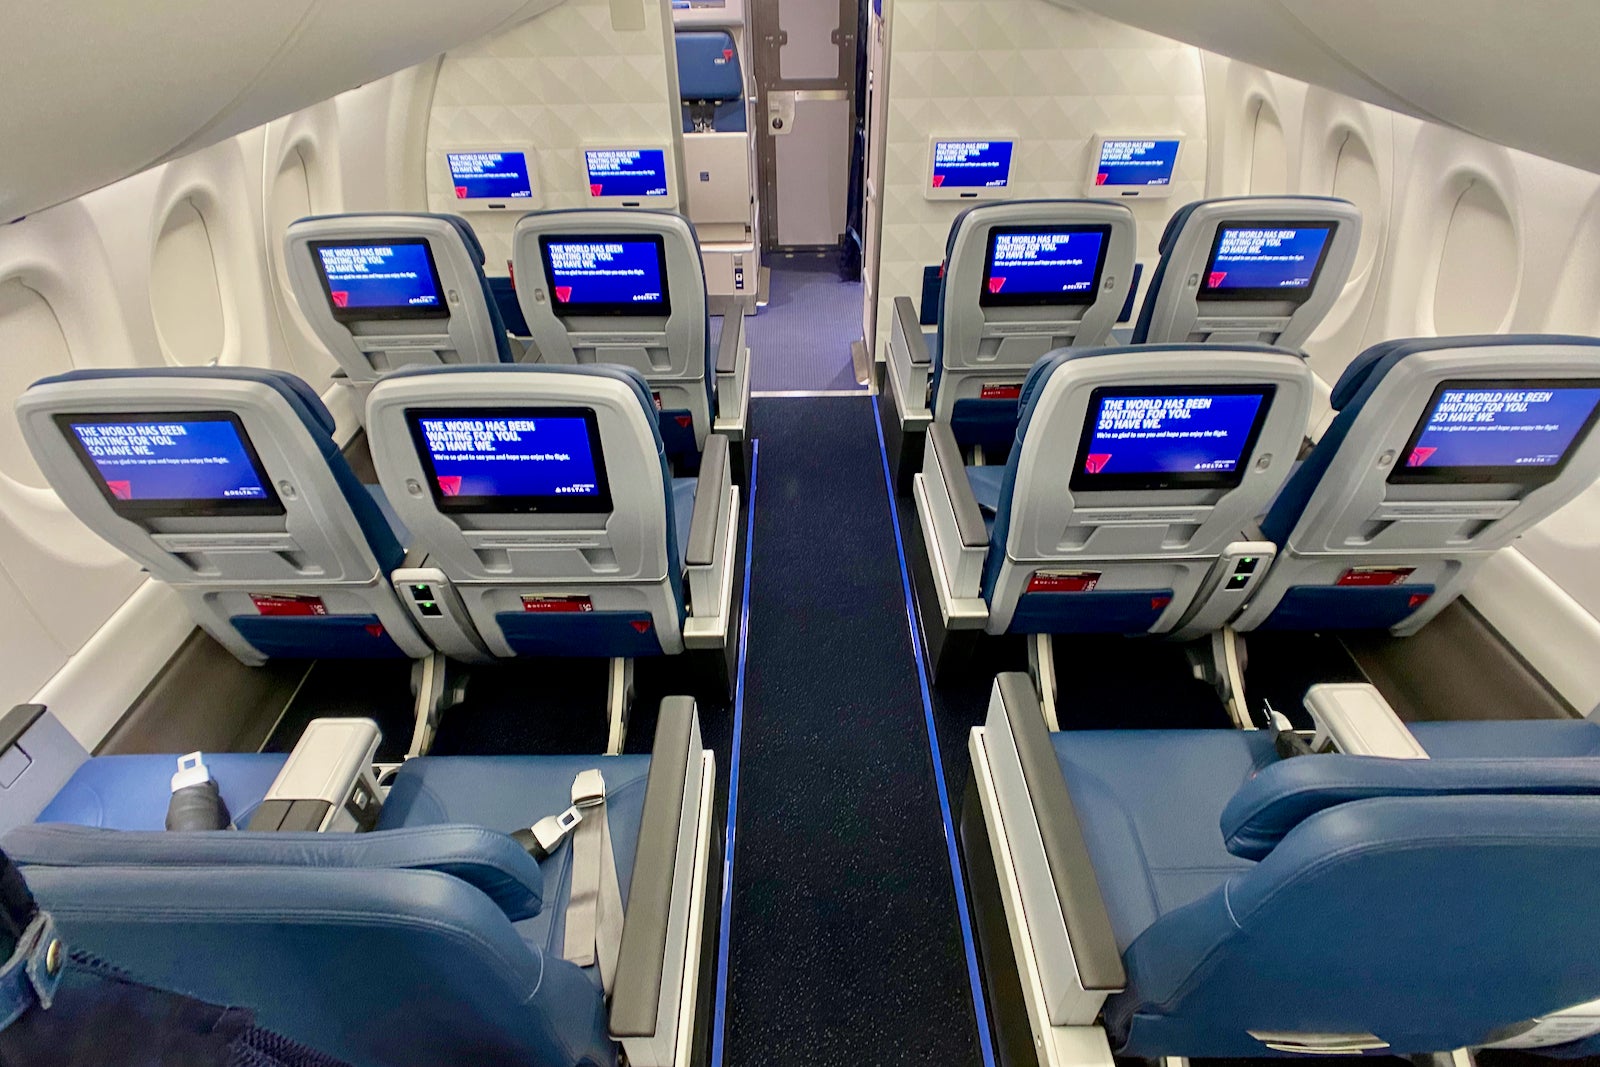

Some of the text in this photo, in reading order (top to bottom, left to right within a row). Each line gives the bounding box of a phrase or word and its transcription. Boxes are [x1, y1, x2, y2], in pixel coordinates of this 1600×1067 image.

[1037, 236, 1052, 244] HAS
[1052, 235, 1070, 244] BEEN
[1238, 231, 1264, 239] WORLD
[1278, 231, 1296, 239] BEEN
[334, 249, 360, 257] WORLD
[360, 248, 375, 256] HAS
[374, 248, 394, 256] BEEN
[564, 245, 590, 253] WORLD
[605, 244, 623, 253] BEEN
[551, 252, 614, 260] WAITING FOR YOU.
[996, 251, 1006, 259] SO
[1024, 250, 1038, 258] WE.
[323, 256, 385, 265] WAITING FOR YOU.
[336, 264, 356, 272] HAVE
[353, 264, 369, 272] WE.
[1444, 392, 1553, 402] THE WORLD HAS BEEN
[1104, 398, 1212, 410] THE WORLD HAS BEEN
[1438, 402, 1528, 412] WAITING FOR YOU.
[1101, 409, 1191, 420] WAITING FOR YOU.
[1432, 412, 1495, 422] SO HAVE WE.
[423, 421, 535, 431] THE WORLD HAS BEEN
[1098, 420, 1161, 430] SO HAVE WE.
[75, 425, 187, 436] THE WORLD HAS BEEN
[81, 436, 176, 446] WAITING FOR YOU.
[426, 431, 521, 441] WAITING FOR YOU.
[88, 446, 154, 456] SO HAVE WE.
[430, 441, 496, 451] SO HAVE WE.
